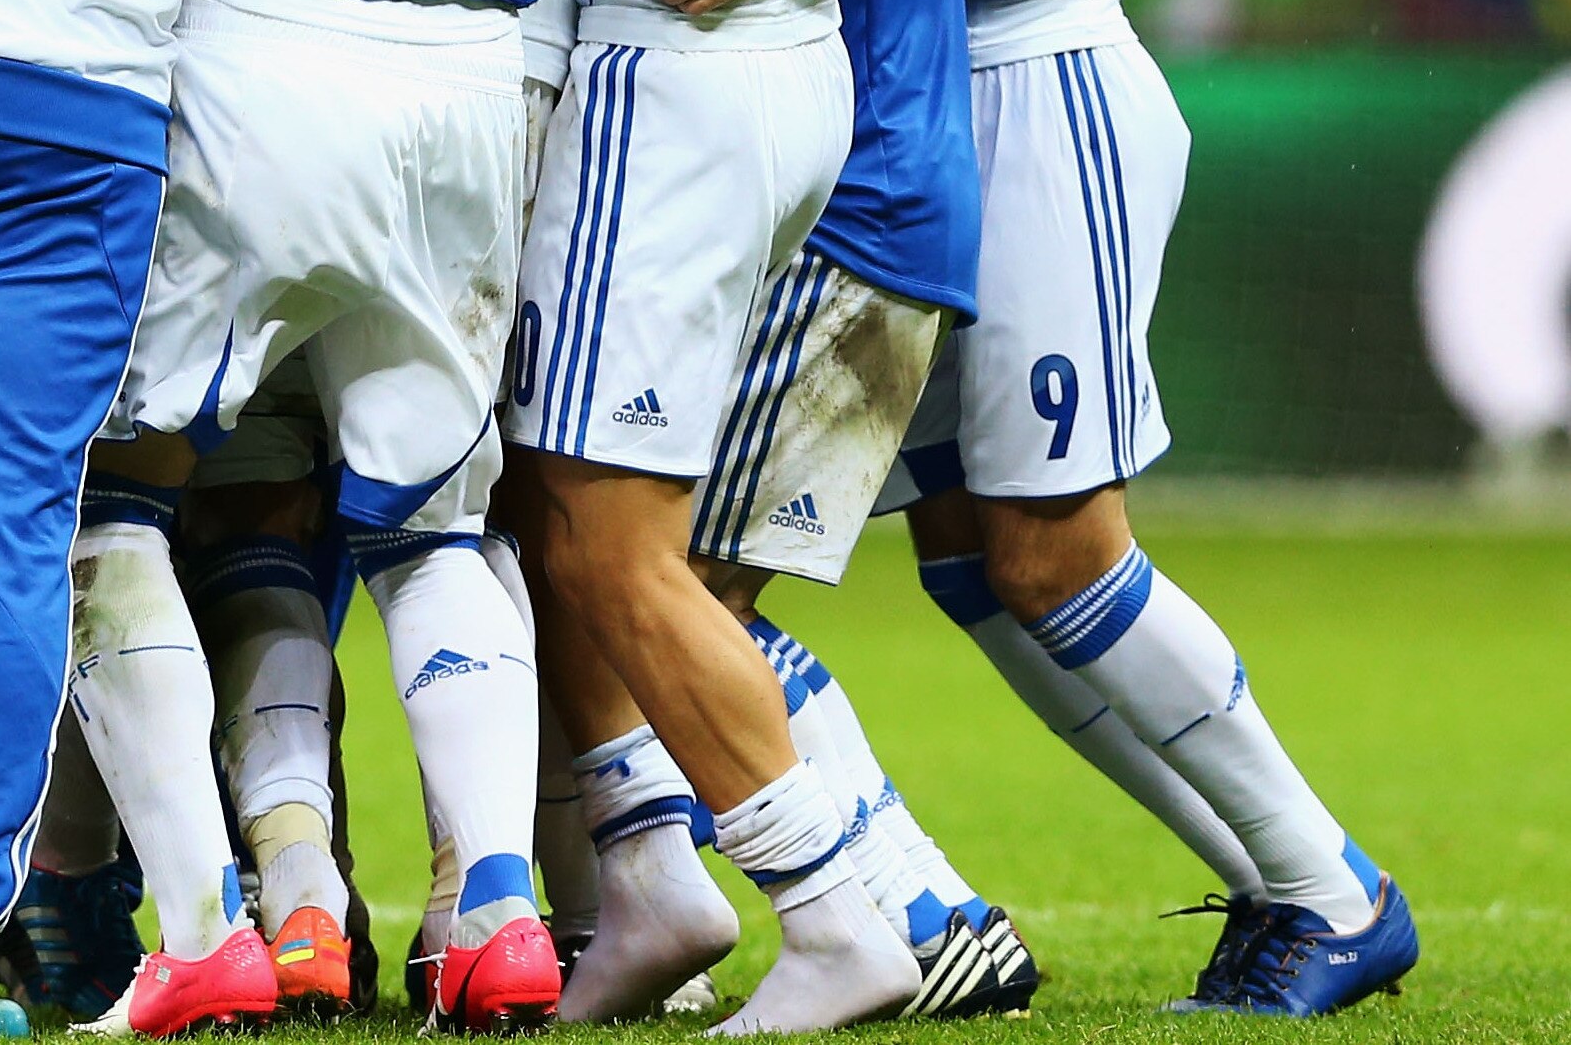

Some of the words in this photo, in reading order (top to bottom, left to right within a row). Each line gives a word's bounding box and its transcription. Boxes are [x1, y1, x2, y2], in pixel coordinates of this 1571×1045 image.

[612, 409, 668, 428] adidas
[1030, 353, 1078, 460] 9
[768, 513, 826, 535] adidas
[405, 661, 489, 701] adidas
